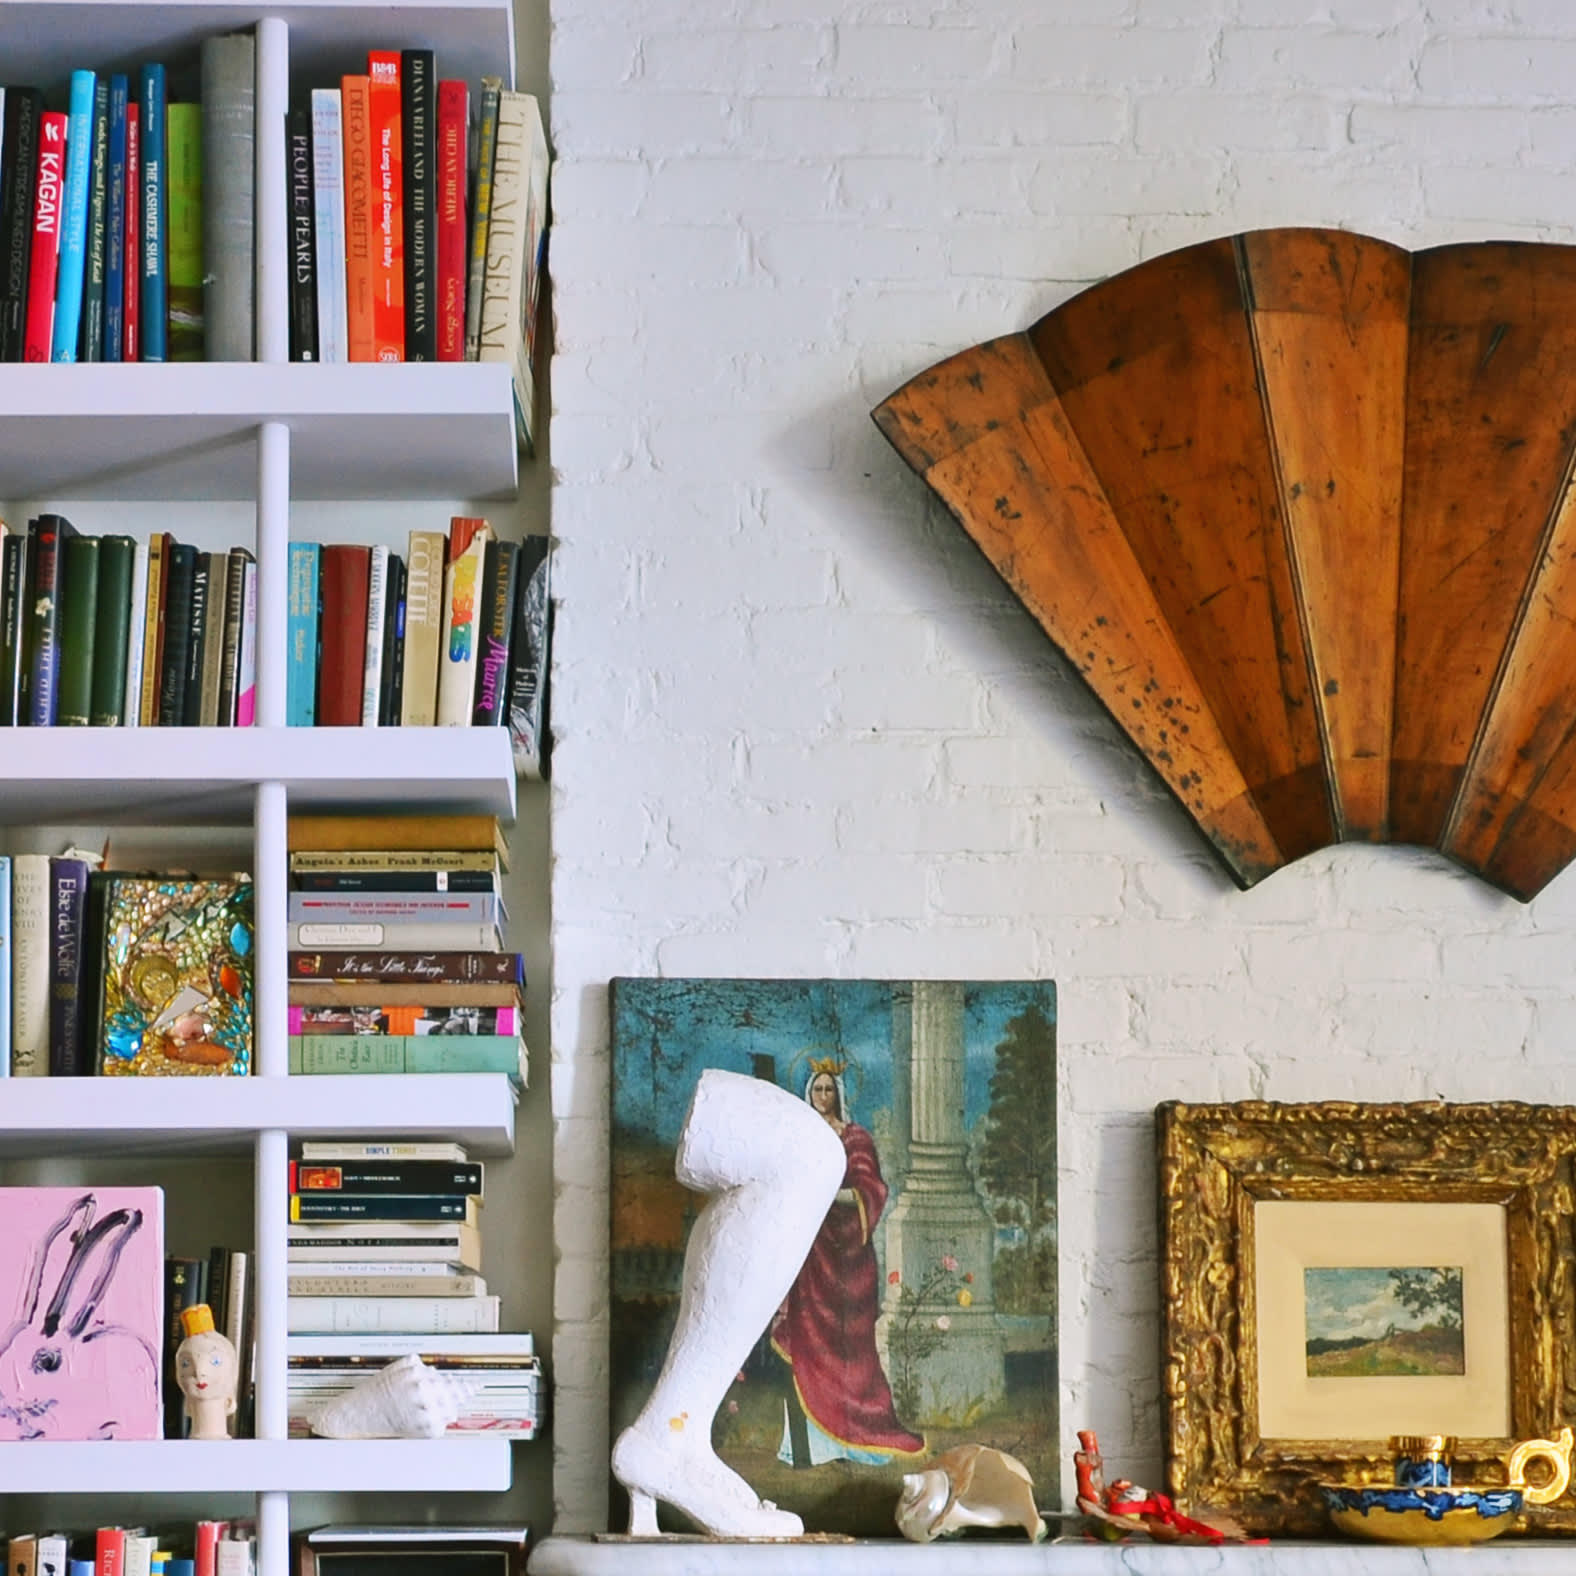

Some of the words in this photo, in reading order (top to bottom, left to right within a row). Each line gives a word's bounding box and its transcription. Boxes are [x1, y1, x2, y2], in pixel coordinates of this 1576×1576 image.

[413, 60, 425, 103] DIANA
[349, 88, 364, 144] DIEGO
[382, 129, 391, 145] The
[380, 148, 392, 168] Long
[413, 107, 425, 179] VREELAND
[493, 113, 525, 187] THE
[37, 152, 59, 232] KAGAN
[146, 161, 157, 182] THE
[382, 170, 392, 189] Life
[145, 184, 157, 239] CASHMERE
[351, 149, 367, 260] GIACOMETTI
[382, 191, 392, 200] of
[414, 188, 425, 212] THE
[381, 203, 393, 234] Design
[146, 242, 157, 277] SHAWL
[381, 247, 394, 268] Italy
[383, 237, 393, 245] in
[414, 220, 425, 277] MODERN
[479, 198, 522, 353] MUSEUM
[414, 282, 425, 333] WOMAN
[408, 537, 431, 625] COLETTE
[191, 572, 207, 636] MATISSE
[476, 636, 508, 712] Maurice
[57, 878, 77, 910] Elsie
[57, 912, 74, 932] de
[56, 932, 75, 976] Wolfe
